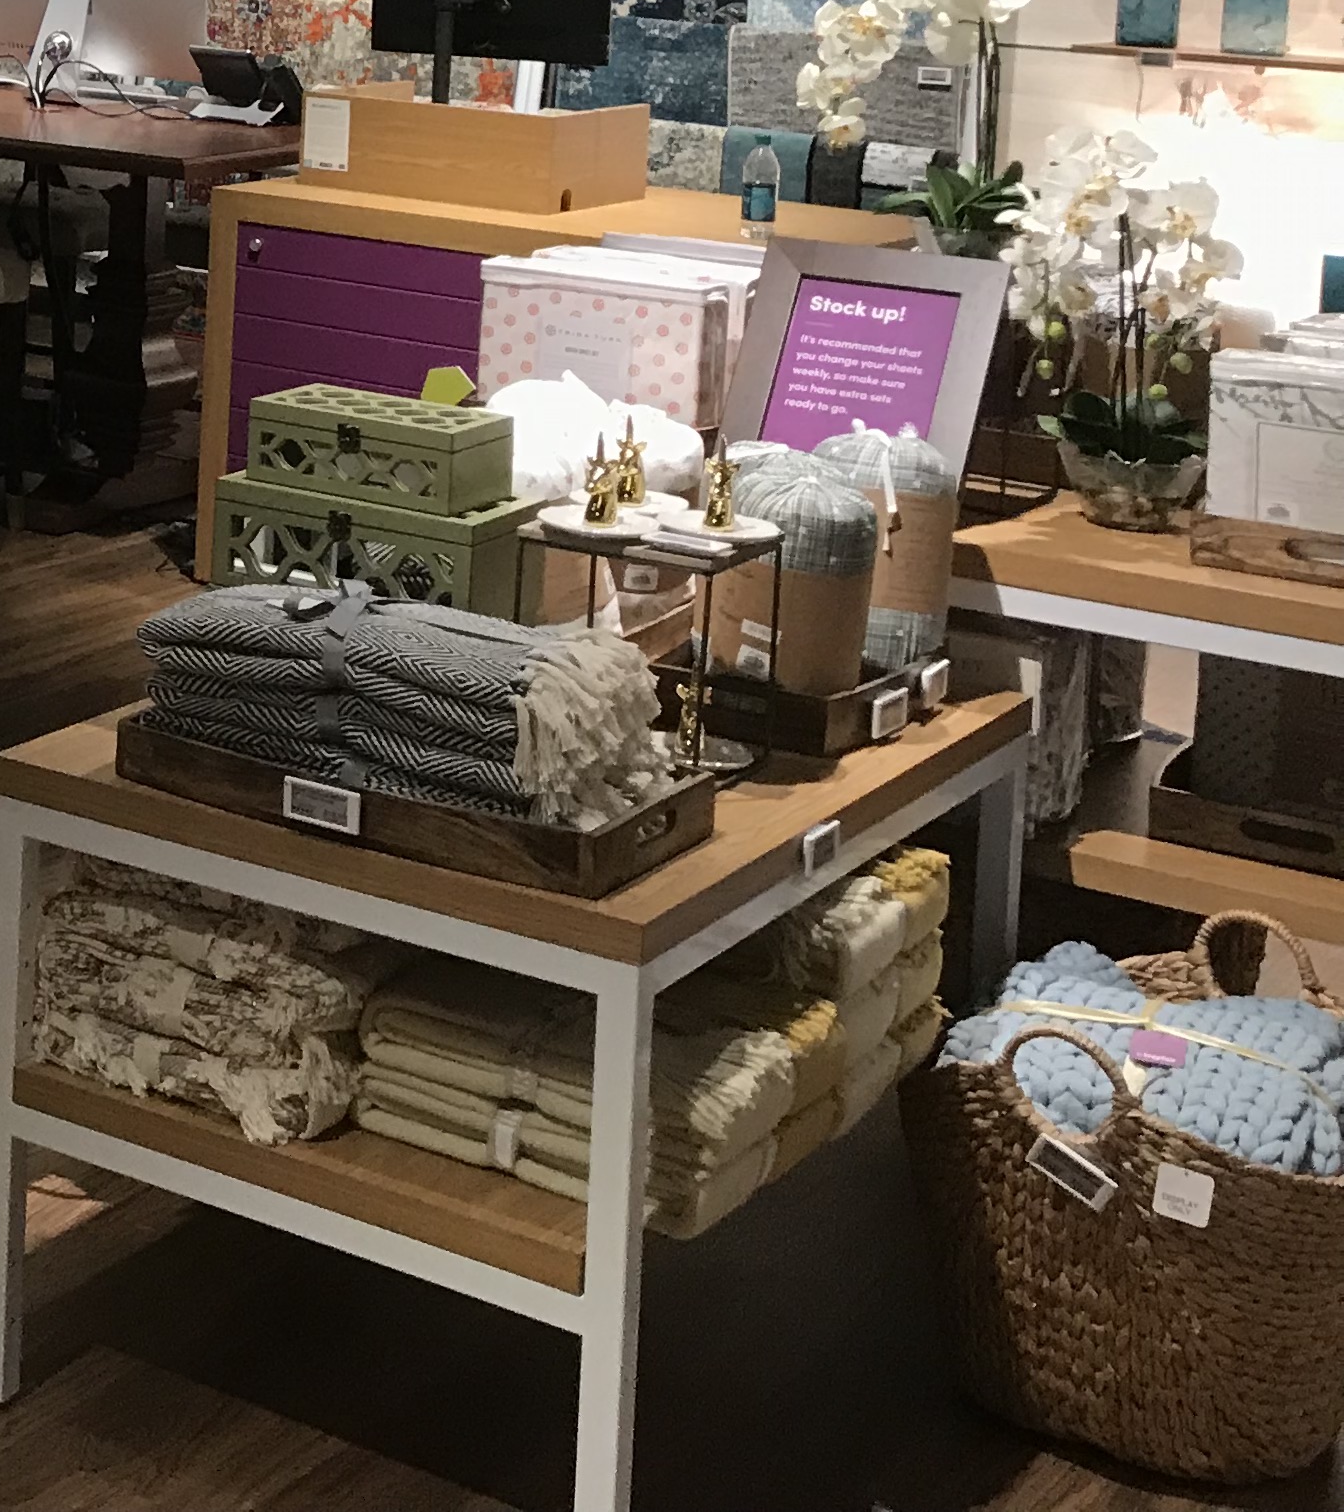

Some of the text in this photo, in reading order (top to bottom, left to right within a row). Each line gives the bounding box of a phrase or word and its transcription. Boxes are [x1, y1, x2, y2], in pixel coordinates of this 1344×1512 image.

[809, 295, 906, 325] Stock up!
[800, 334, 922, 358] It's recommended that
[796, 351, 923, 375] you change your sheets
[833, 372, 846, 381] so
[848, 373, 879, 385] make
[881, 380, 906, 389] sure
[788, 383, 892, 404] you have extra sets
[784, 398, 848, 415] ready to go.
